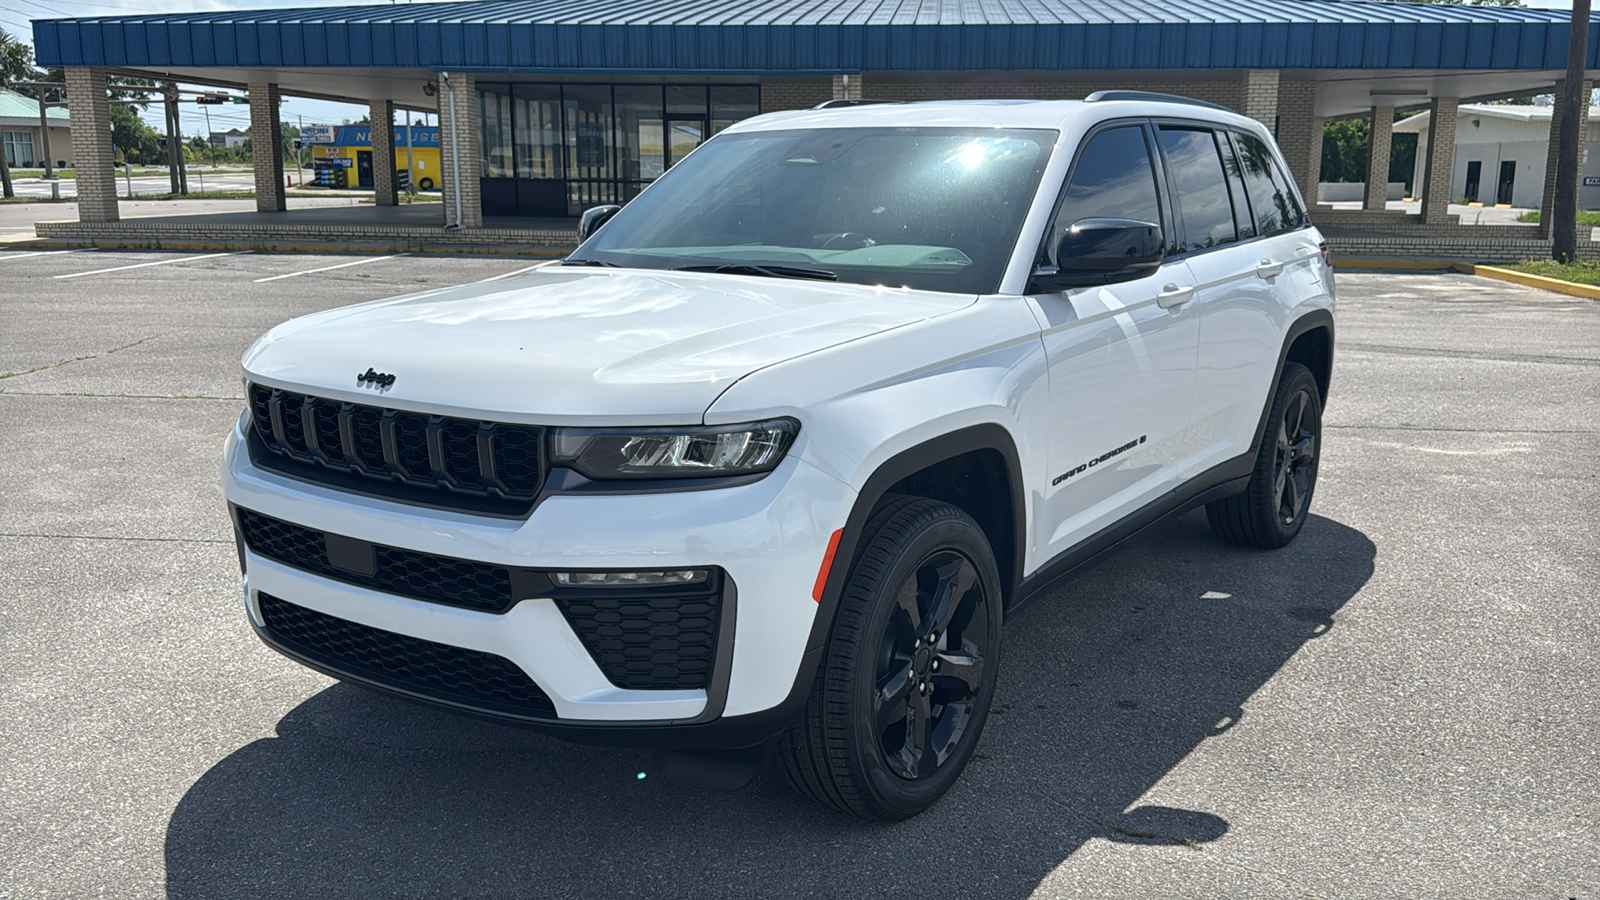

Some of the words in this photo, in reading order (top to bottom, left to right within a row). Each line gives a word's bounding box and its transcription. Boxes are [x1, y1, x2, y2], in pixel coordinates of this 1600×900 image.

[411, 132, 439, 142] USE
[357, 367, 396, 388] Jeep
[1052, 463, 1087, 486] GRAND
[1088, 438, 1138, 467] CHEROKEE
